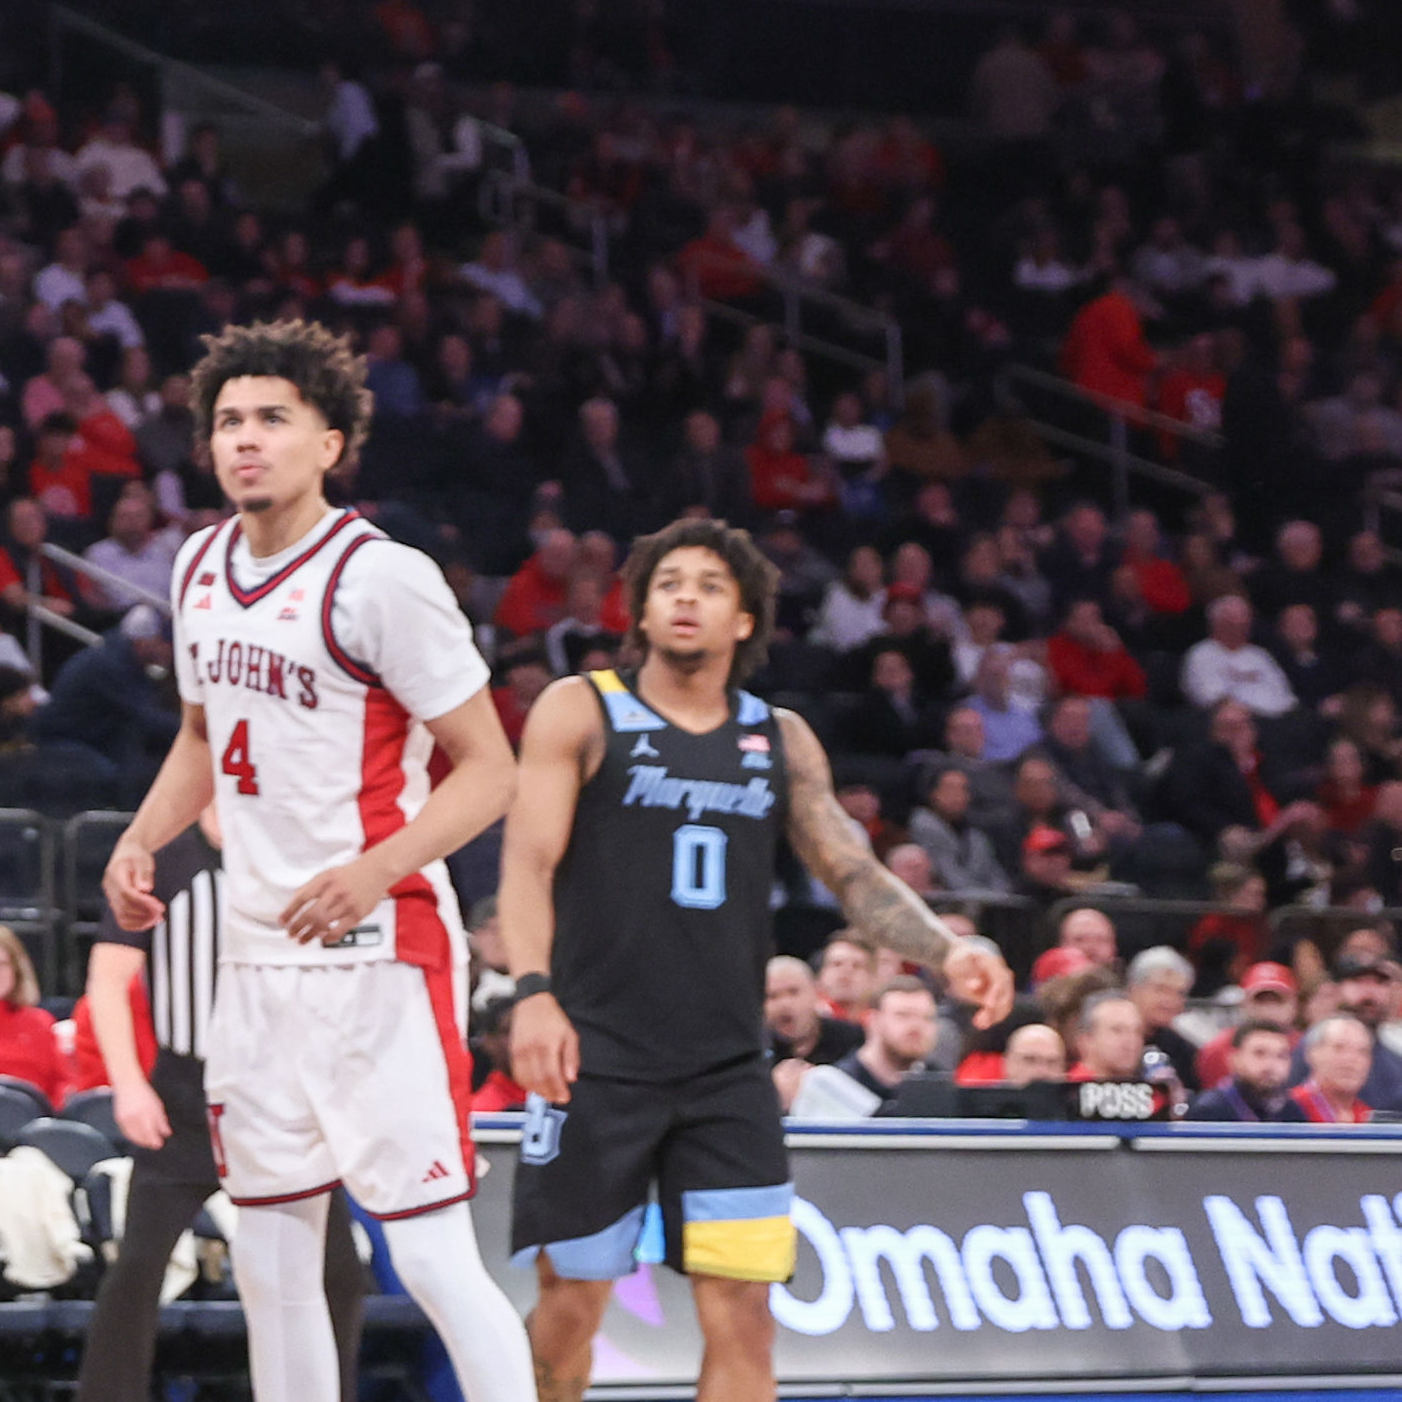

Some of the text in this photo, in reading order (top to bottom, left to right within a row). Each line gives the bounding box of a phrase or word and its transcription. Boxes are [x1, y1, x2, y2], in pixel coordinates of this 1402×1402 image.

[207, 639, 319, 709] JOHN'S
[221, 718, 259, 796] 4
[670, 824, 728, 909] 0
[1202, 1191, 1402, 1330] Nat
